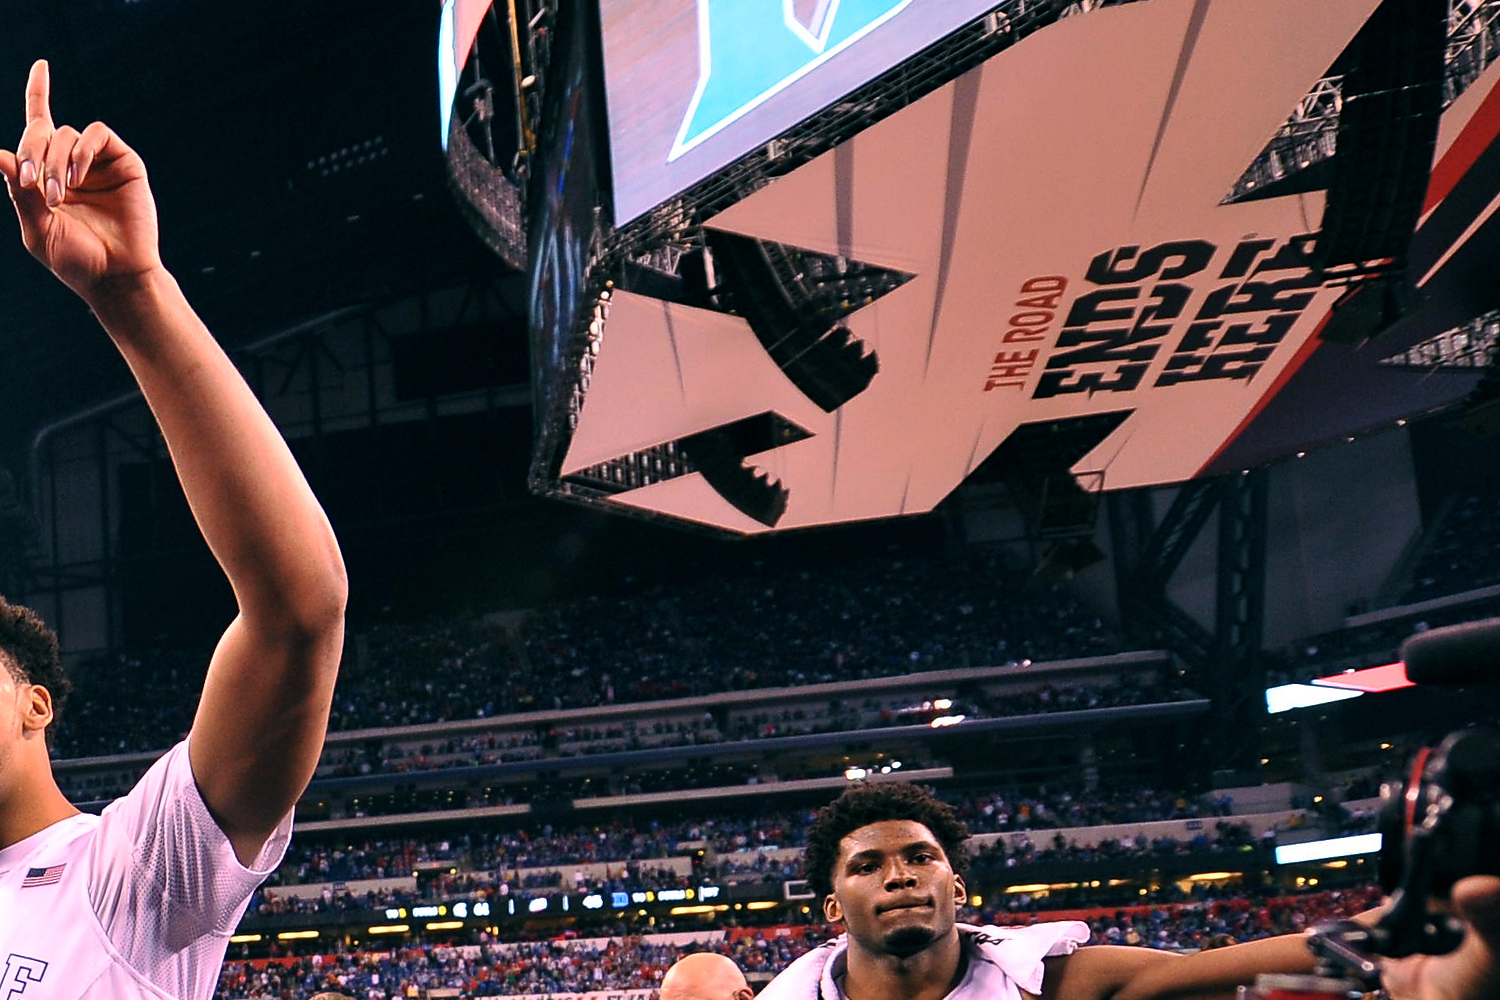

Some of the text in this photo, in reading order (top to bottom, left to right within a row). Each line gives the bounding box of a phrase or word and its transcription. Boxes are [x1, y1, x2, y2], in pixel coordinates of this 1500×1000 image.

[983, 275, 1069, 392] THE ROAD
[1031, 239, 1218, 400] ENDS
